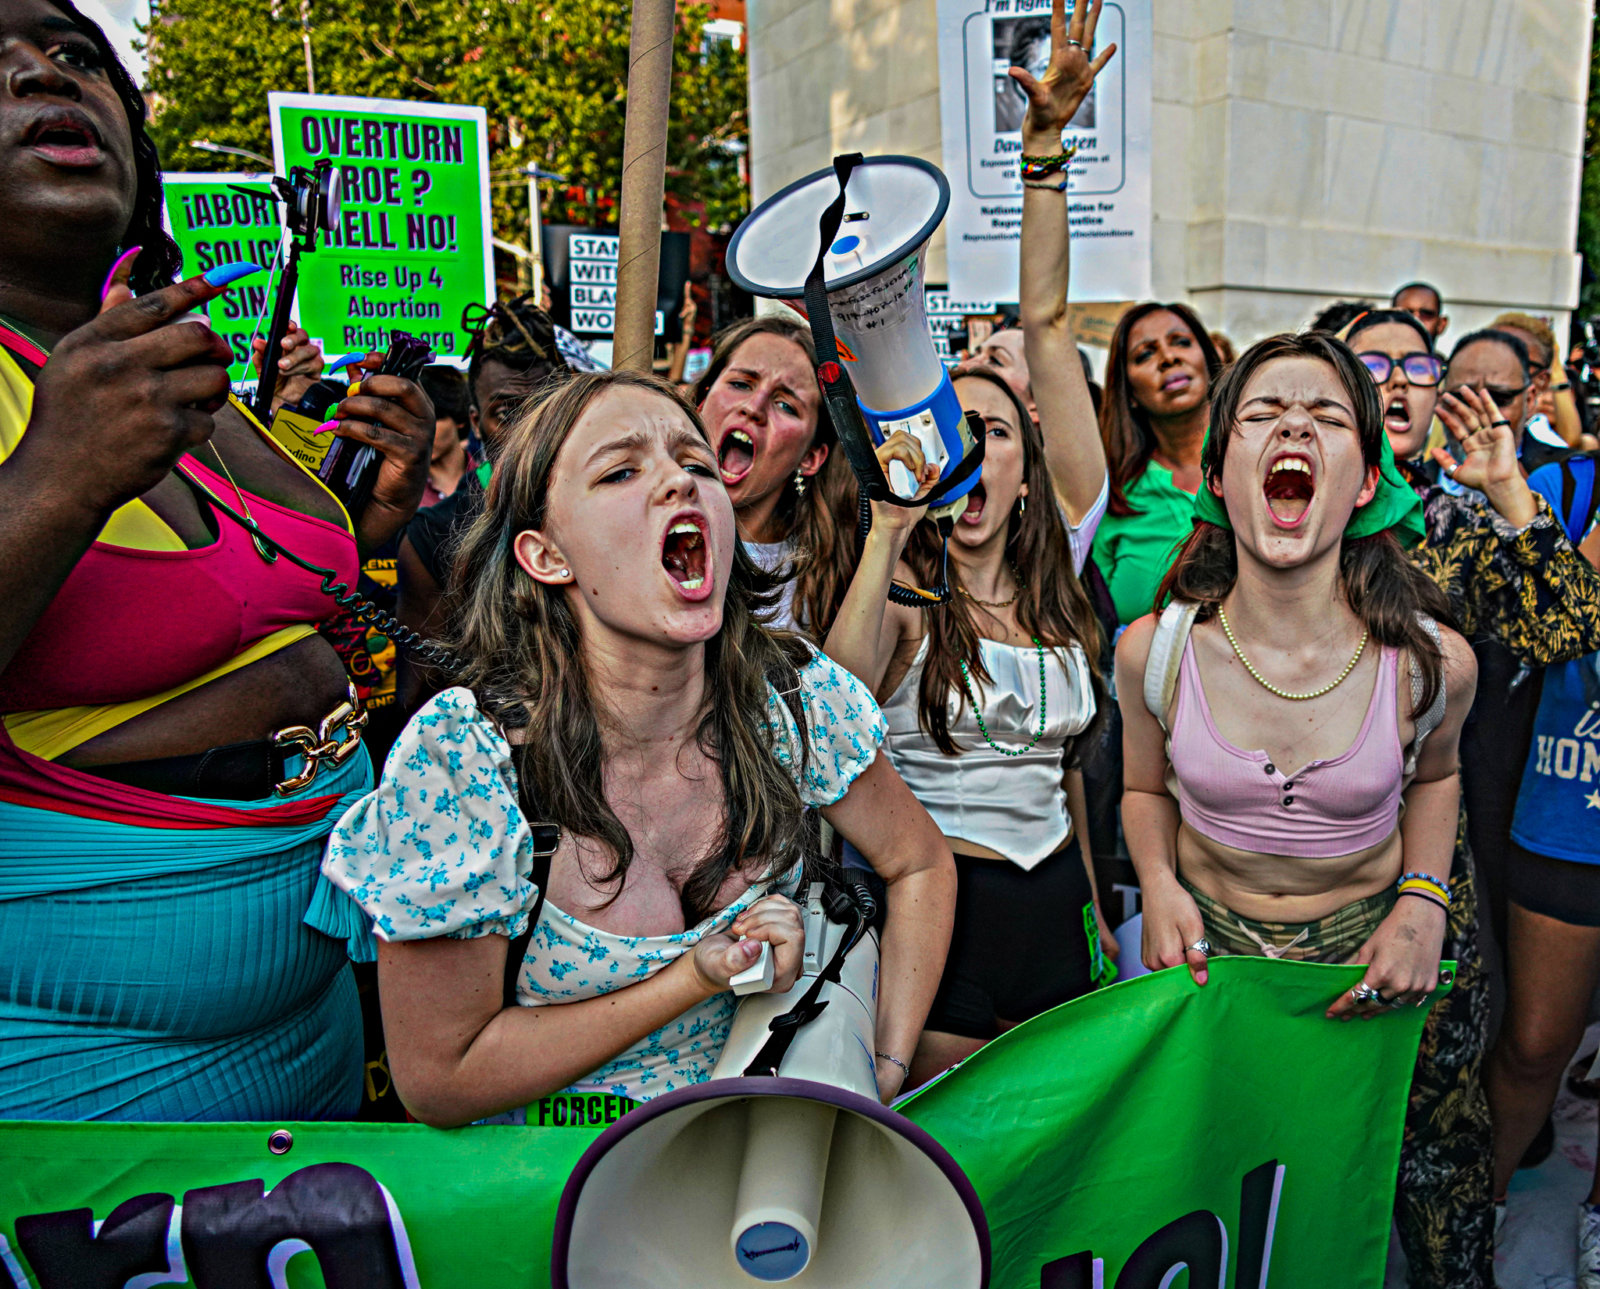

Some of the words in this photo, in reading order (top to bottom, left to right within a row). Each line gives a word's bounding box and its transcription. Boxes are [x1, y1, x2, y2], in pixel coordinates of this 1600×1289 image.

[301, 115, 464, 164] OVERTURN
[340, 165, 403, 207] ROE
[411, 169, 432, 207] ?
[981, 206, 1023, 217] Nationa
[325, 211, 398, 250] HELL
[407, 213, 459, 252] NO!
[574, 239, 619, 256] STAN
[340, 264, 388, 289] Rise
[394, 265, 424, 293] Up
[429, 266, 443, 289] 4
[348, 295, 441, 319] Abortion
[574, 288, 616, 304] BLA
